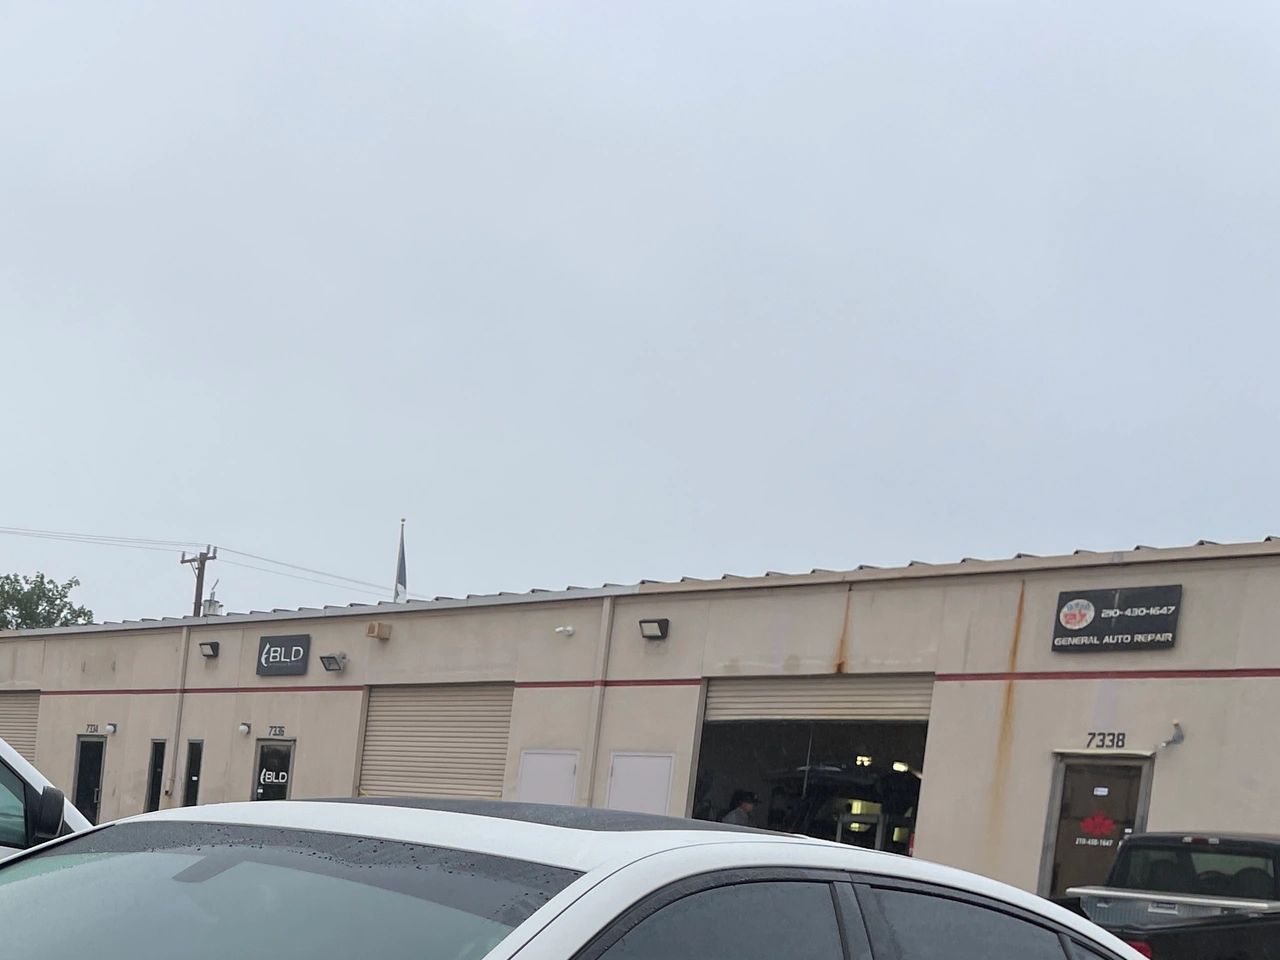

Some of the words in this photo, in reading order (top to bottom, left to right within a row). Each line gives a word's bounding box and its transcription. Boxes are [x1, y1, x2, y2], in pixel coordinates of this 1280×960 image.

[1054, 635, 1099, 646] GENERAL
[1102, 634, 1131, 644] AUTO
[1134, 632, 1173, 643] REPAIR
[1086, 732, 1126, 748] 7338
